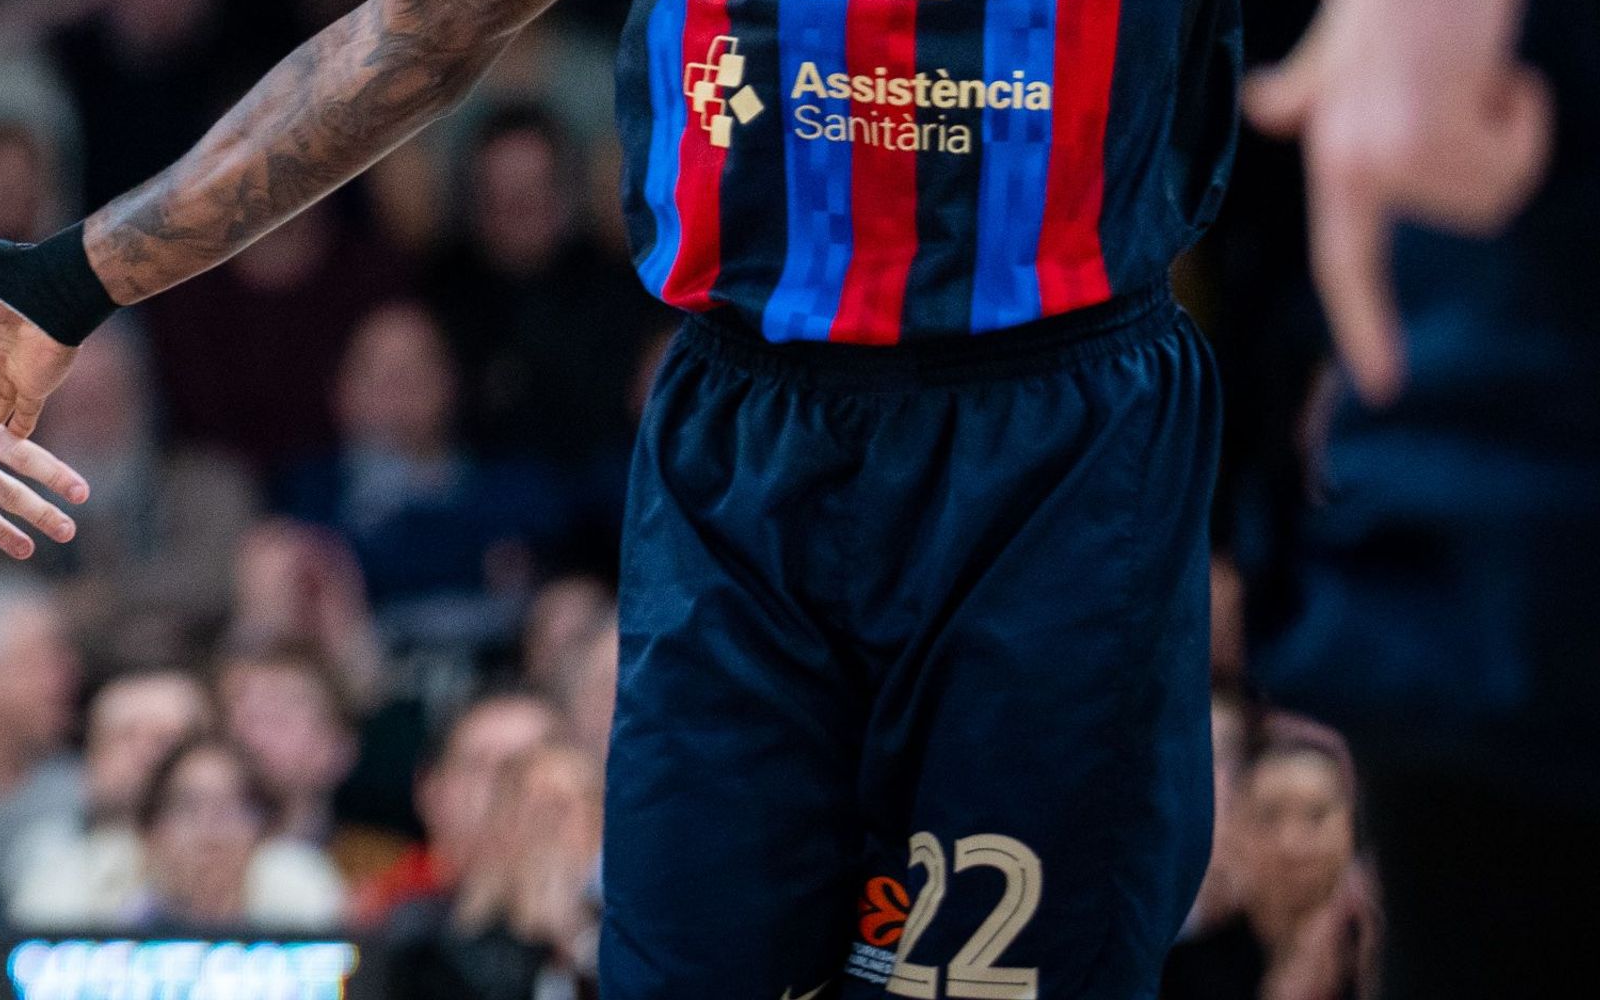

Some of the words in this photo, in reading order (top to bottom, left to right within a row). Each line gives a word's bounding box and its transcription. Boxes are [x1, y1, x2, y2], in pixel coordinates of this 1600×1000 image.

[791, 61, 1051, 111] Assistència
[793, 104, 973, 154] Sanitària
[885, 831, 1043, 1000] 22
